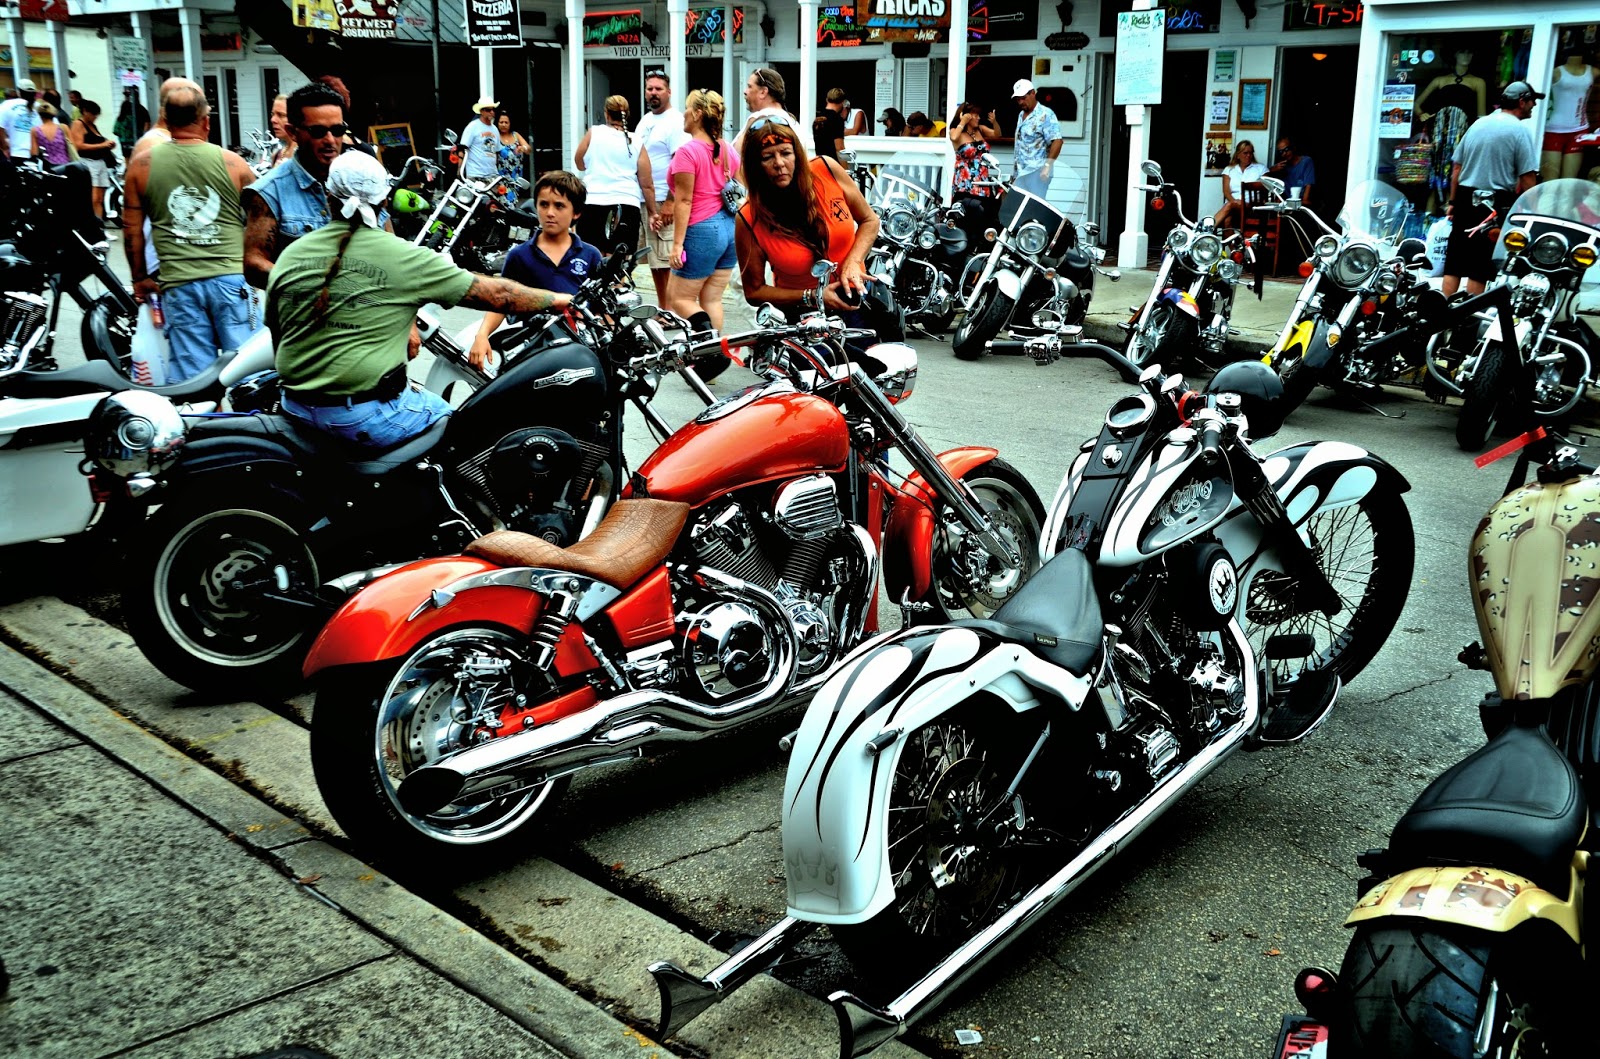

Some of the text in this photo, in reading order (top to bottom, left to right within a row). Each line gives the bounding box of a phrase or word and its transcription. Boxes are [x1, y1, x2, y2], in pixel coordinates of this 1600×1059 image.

[472, 0, 514, 17] PIZZERIA
[341, 17, 363, 28] KEY
[364, 18, 394, 29] WEST
[698, 9, 721, 44] SUBS
[617, 34, 640, 43] PIZZA
[614, 45, 703, 57] VIDEO ENTERTENT
